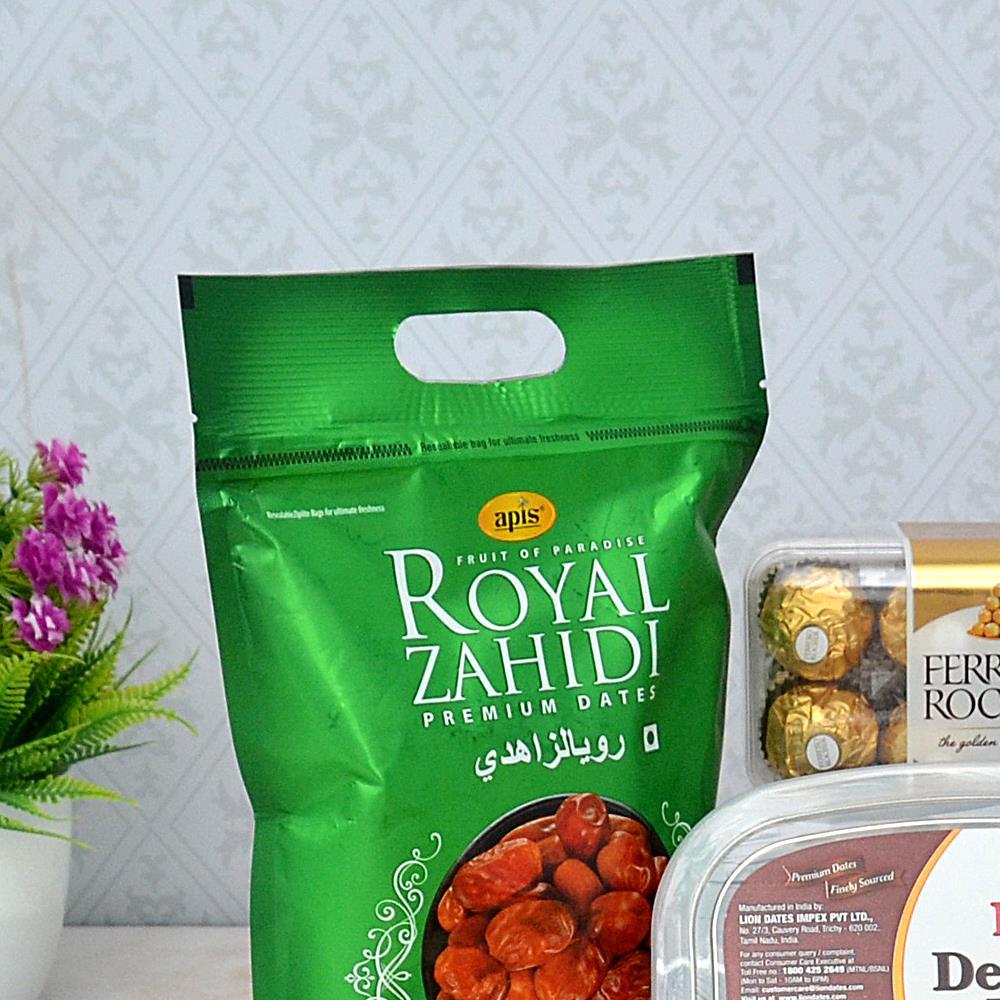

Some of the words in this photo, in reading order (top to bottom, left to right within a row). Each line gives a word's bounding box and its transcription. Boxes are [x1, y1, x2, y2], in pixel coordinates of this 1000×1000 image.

[470, 438, 487, 450] bag
[488, 436, 501, 447] for
[494, 505, 540, 533] apis
[457, 550, 508, 566] FRUIT
[520, 546, 541, 559] OF
[553, 535, 646, 556] PARADISE
[384, 547, 670, 640] ROYAL
[405, 620, 660, 705] ZAHIDI
[423, 699, 557, 728] PREMIUM
[578, 685, 656, 711] DATES
[938, 733, 957, 748] the
[955, 734, 997, 753] golden
[791, 868, 831, 882] Premium
[832, 861, 857, 874] Dates
[830, 882, 858, 895] Finely
[858, 872, 895, 888] Sourced
[738, 904, 786, 912] Manufactured
[795, 903, 812, 911] India
[739, 915, 762, 925] LION
[763, 914, 794, 924] DATES
[796, 913, 828, 923] IMPEX
[829, 912, 848, 922] PVT
[782, 966, 804, 975] 1800
